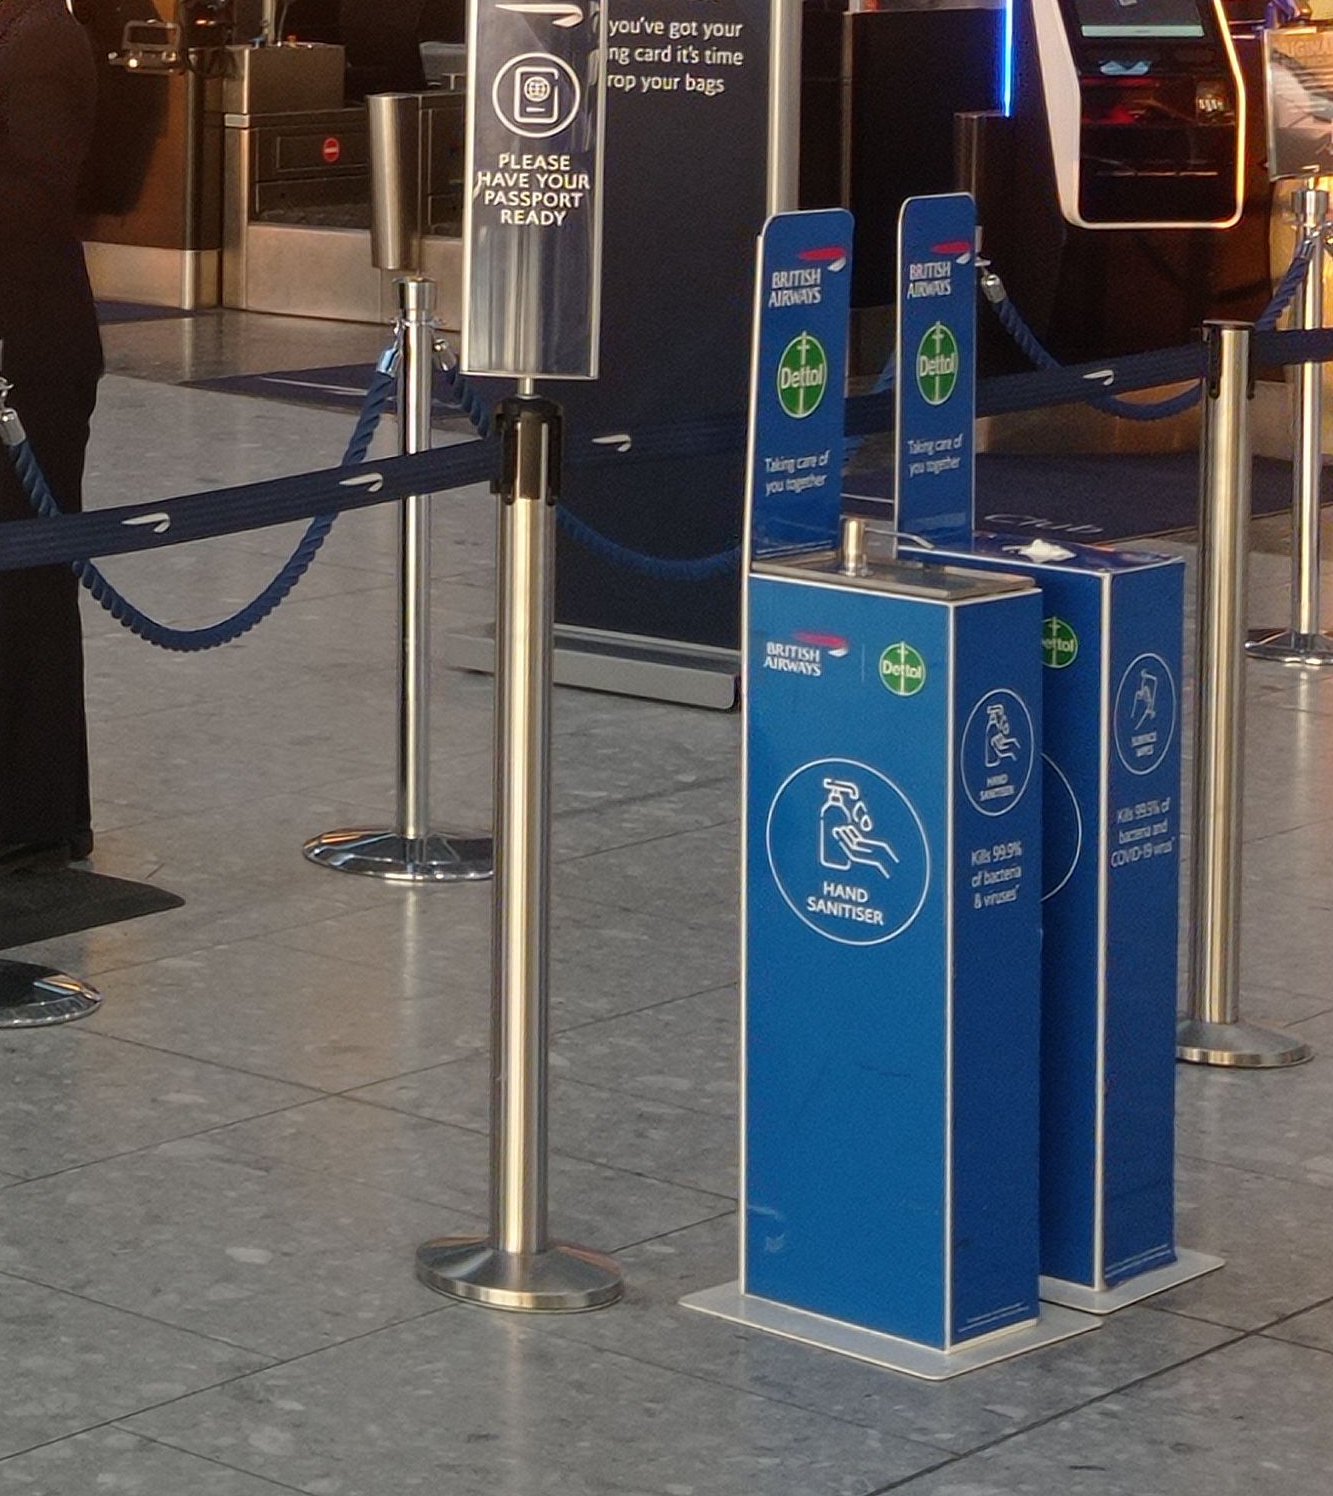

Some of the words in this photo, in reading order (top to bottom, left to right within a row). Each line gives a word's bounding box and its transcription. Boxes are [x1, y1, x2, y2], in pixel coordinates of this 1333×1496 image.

[609, 17, 665, 36] you've
[668, 20, 698, 40] got
[703, 22, 743, 40] your
[634, 45, 672, 63] card
[676, 45, 700, 63] it's
[704, 46, 745, 66] time
[607, 74, 636, 92] rop
[640, 75, 680, 93] your
[685, 72, 725, 96] bags
[499, 152, 571, 171] PLEASE
[477, 171, 530, 188] HAVE
[535, 173, 590, 190] YOUR
[484, 190, 583, 208] PASSPORT
[500, 209, 567, 226] READY
[772, 268, 821, 288] BRITISH
[909, 261, 951, 280] BRITISH
[768, 286, 822, 308] AIRWAYS
[907, 278, 951, 300] AIRWAYS
[920, 353, 956, 377] Dettol
[780, 363, 823, 390] Dettol
[765, 457, 795, 475] Taking
[796, 455, 818, 469] care
[818, 450, 831, 467] of
[765, 479, 784, 497] you
[766, 641, 820, 662] BRITISH
[763, 656, 822, 677] AIRWAYS
[883, 660, 923, 679] Dettol
[971, 849, 992, 866] Kills
[1110, 844, 1153, 868] COVID-19
[971, 870, 983, 888] of
[823, 881, 869, 903] HAND
[806, 896, 884, 926] SANITISER
